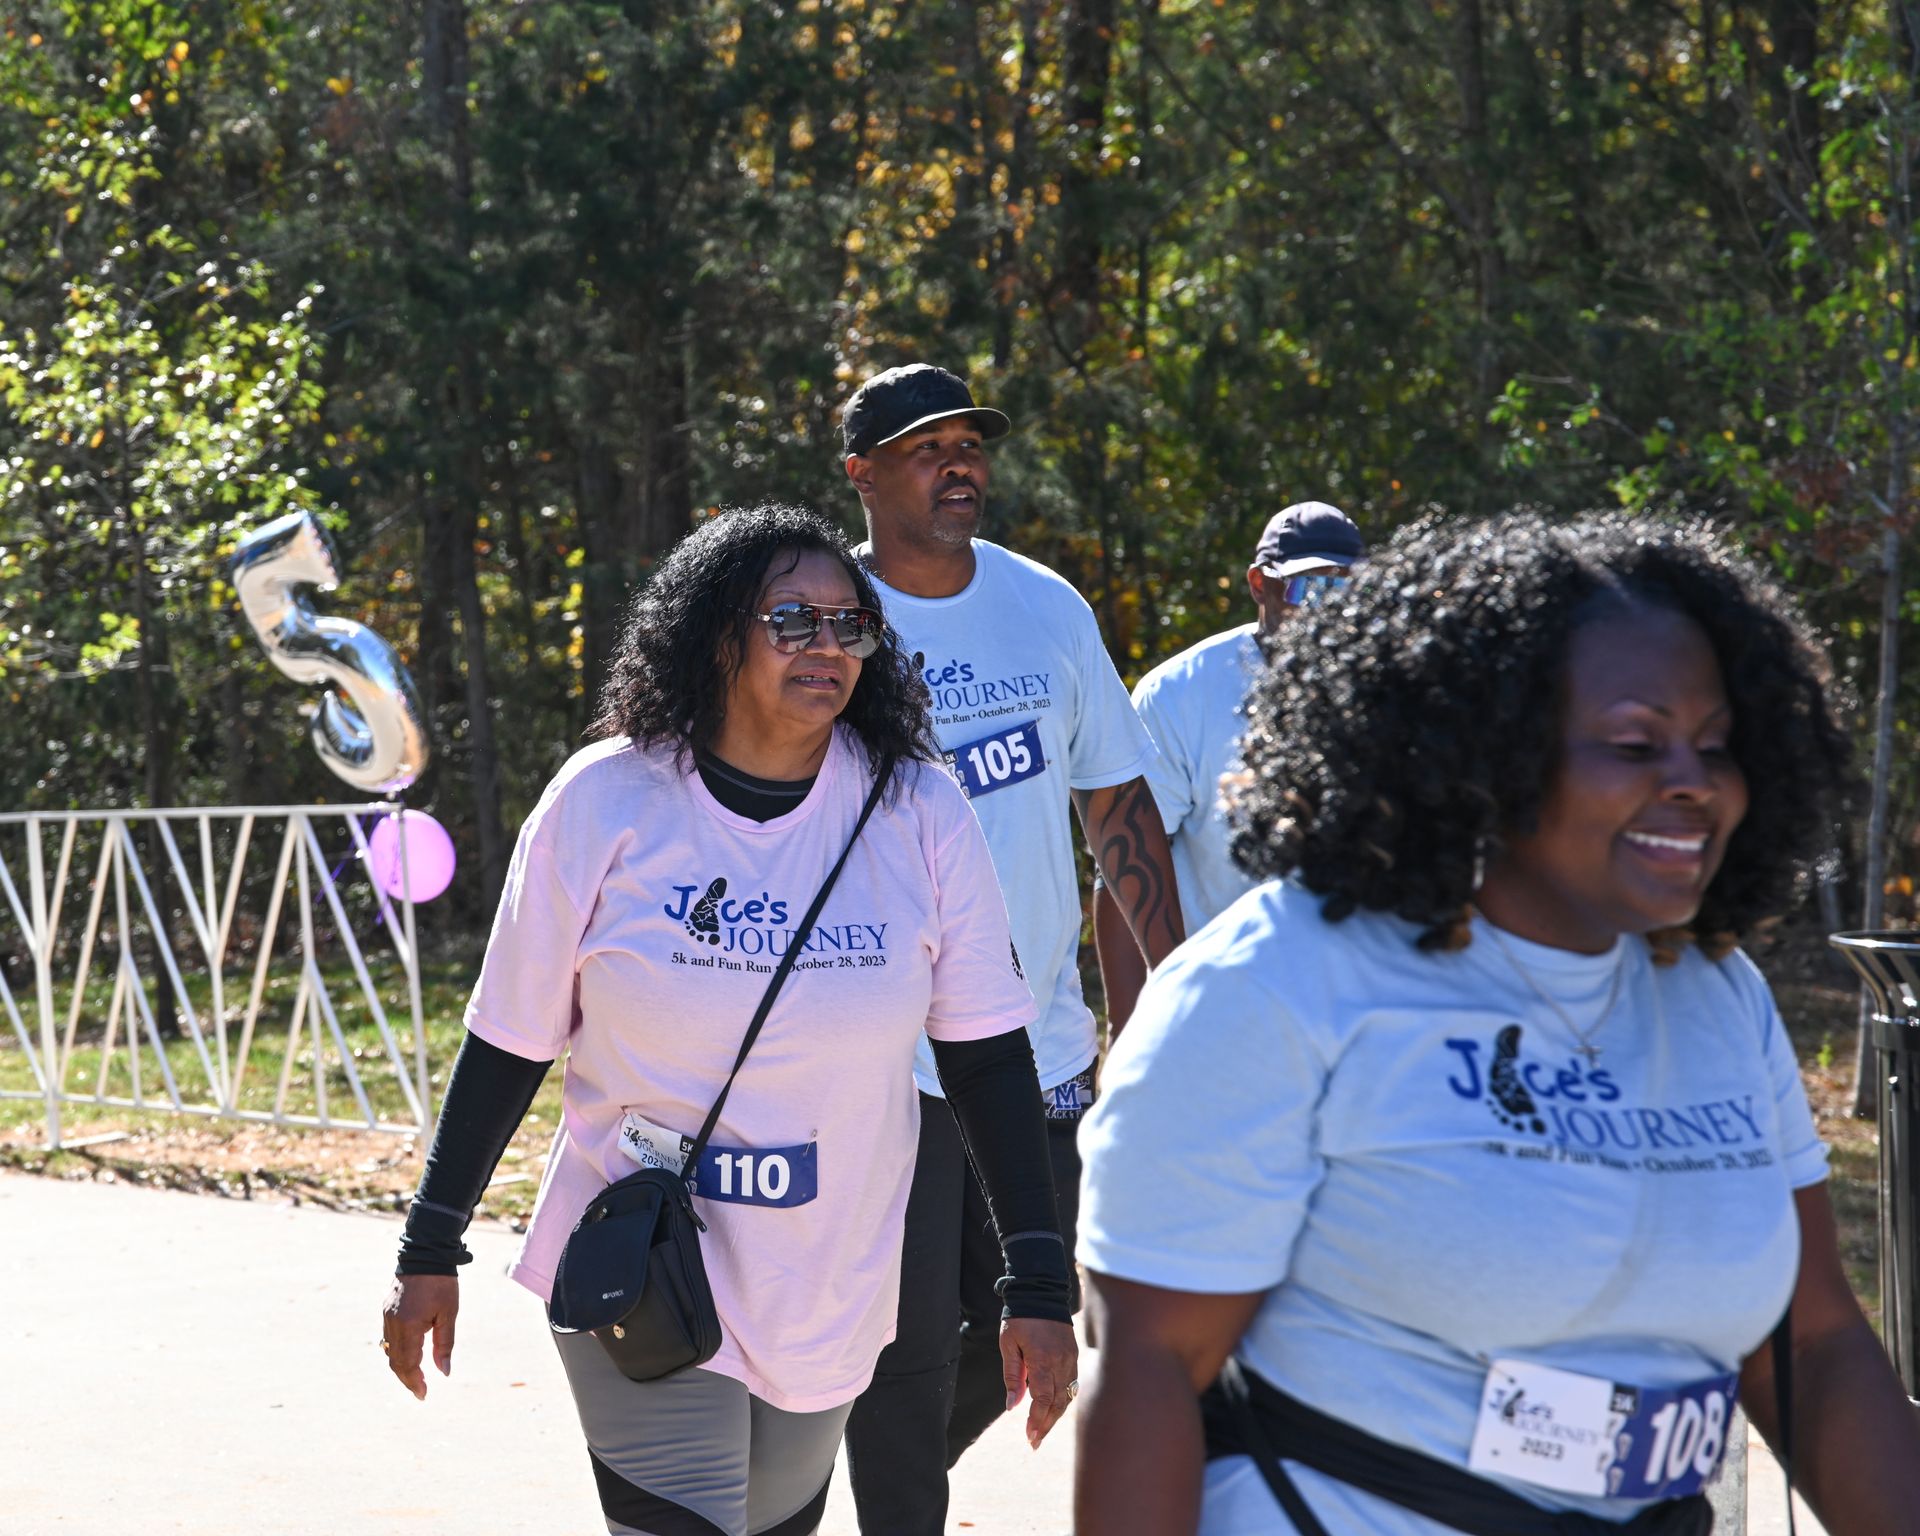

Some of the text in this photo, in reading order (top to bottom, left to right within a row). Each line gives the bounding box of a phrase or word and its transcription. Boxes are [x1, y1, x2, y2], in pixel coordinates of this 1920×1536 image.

[230, 509, 430, 793] 5
[925, 659, 975, 687] ce's
[934, 673, 1052, 711] JOURNEY
[935, 714, 951, 725] Fun
[952, 713, 971, 723] Run
[978, 704, 1016, 720] October
[1018, 701, 1031, 713] 28,
[1033, 698, 1052, 710] 2023
[944, 753, 956, 764] 5K
[967, 731, 1032, 787] 105
[671, 952, 687, 965] 5k
[690, 955, 714, 968] and
[718, 957, 742, 971] Fun
[746, 961, 772, 974] Run
[837, 956, 856, 968] 28,
[859, 955, 887, 967] 2023
[1055, 1082, 1082, 1110] M
[1045, 1108, 1068, 1119] RACK
[1548, 1095, 1764, 1150] JOURNEY
[637, 1141, 679, 1167] JOURNEY
[641, 1153, 665, 1169] 2023
[714, 1152, 791, 1200] 110
[1644, 1390, 1727, 1485] 108
